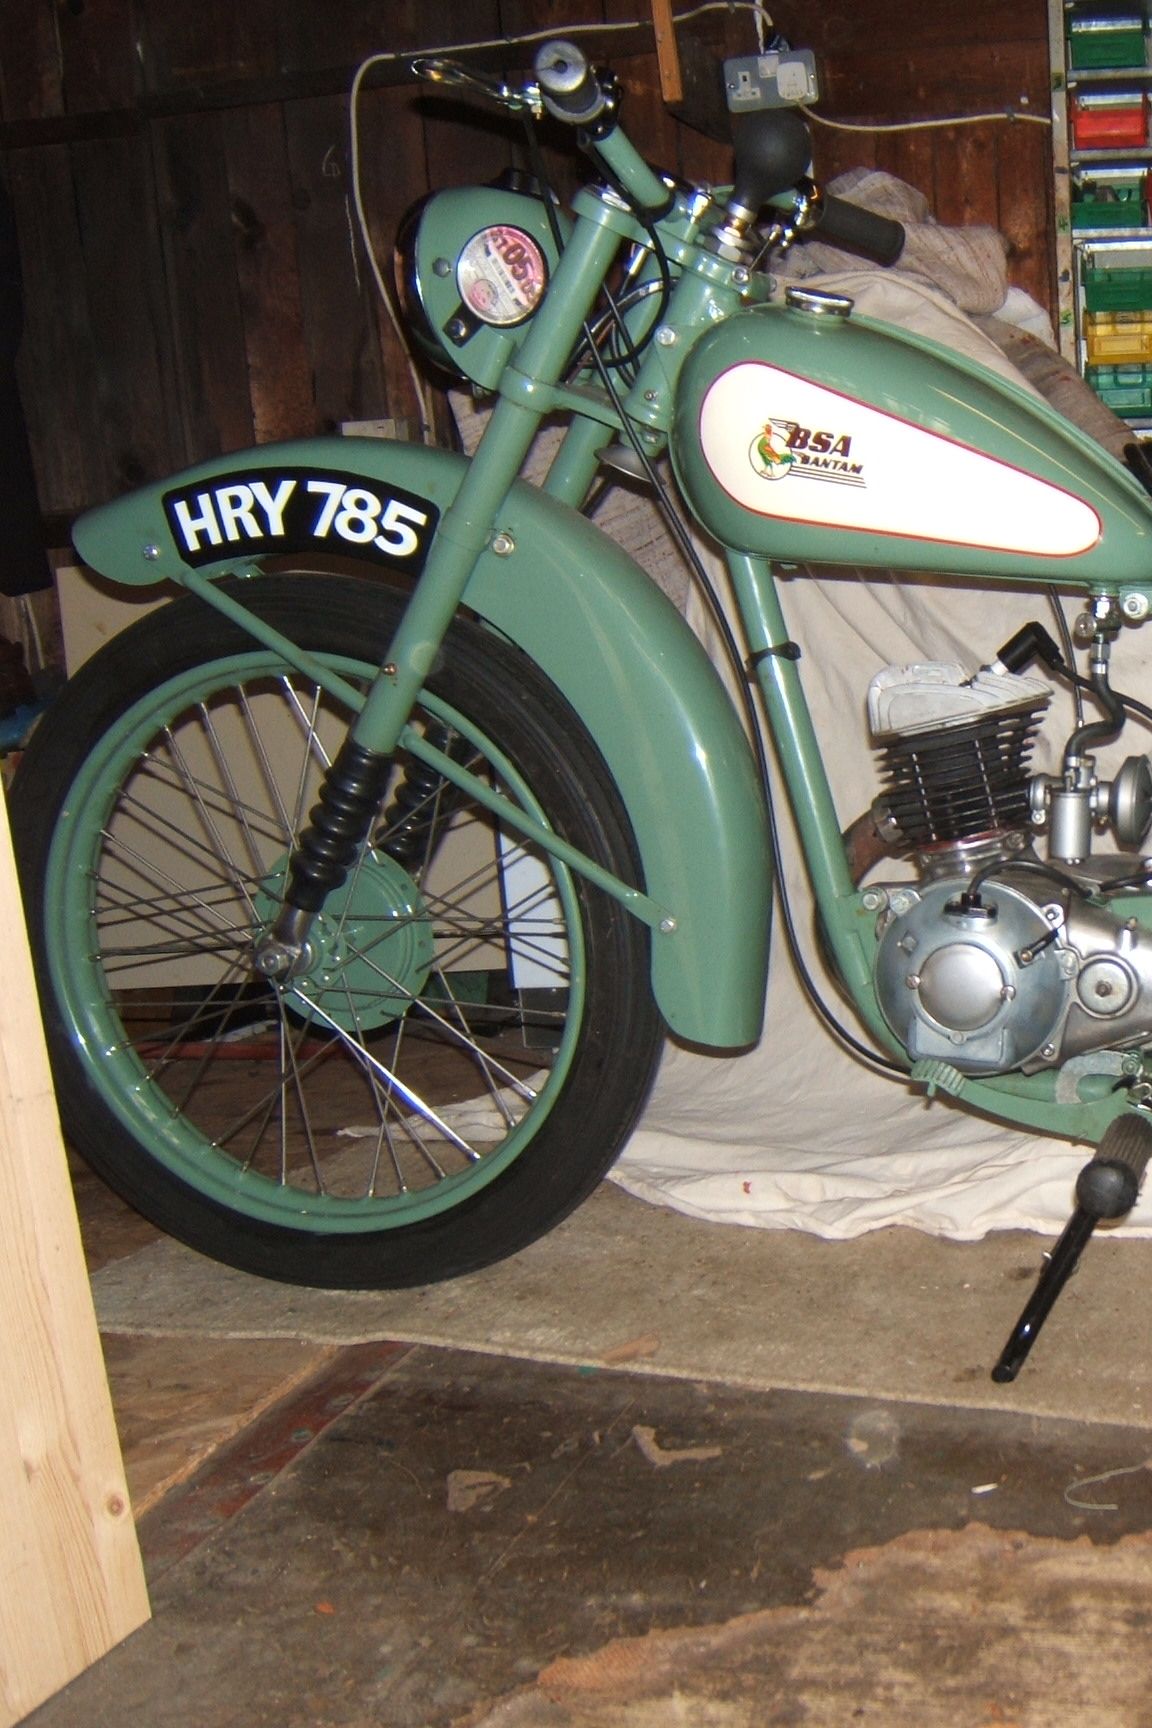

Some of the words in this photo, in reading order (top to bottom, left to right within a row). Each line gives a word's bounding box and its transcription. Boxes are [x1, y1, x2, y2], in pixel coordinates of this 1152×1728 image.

[786, 427, 852, 457] BSA
[800, 453, 864, 474] BANTAM
[173, 480, 297, 552] HRY
[306, 480, 427, 556] 785
